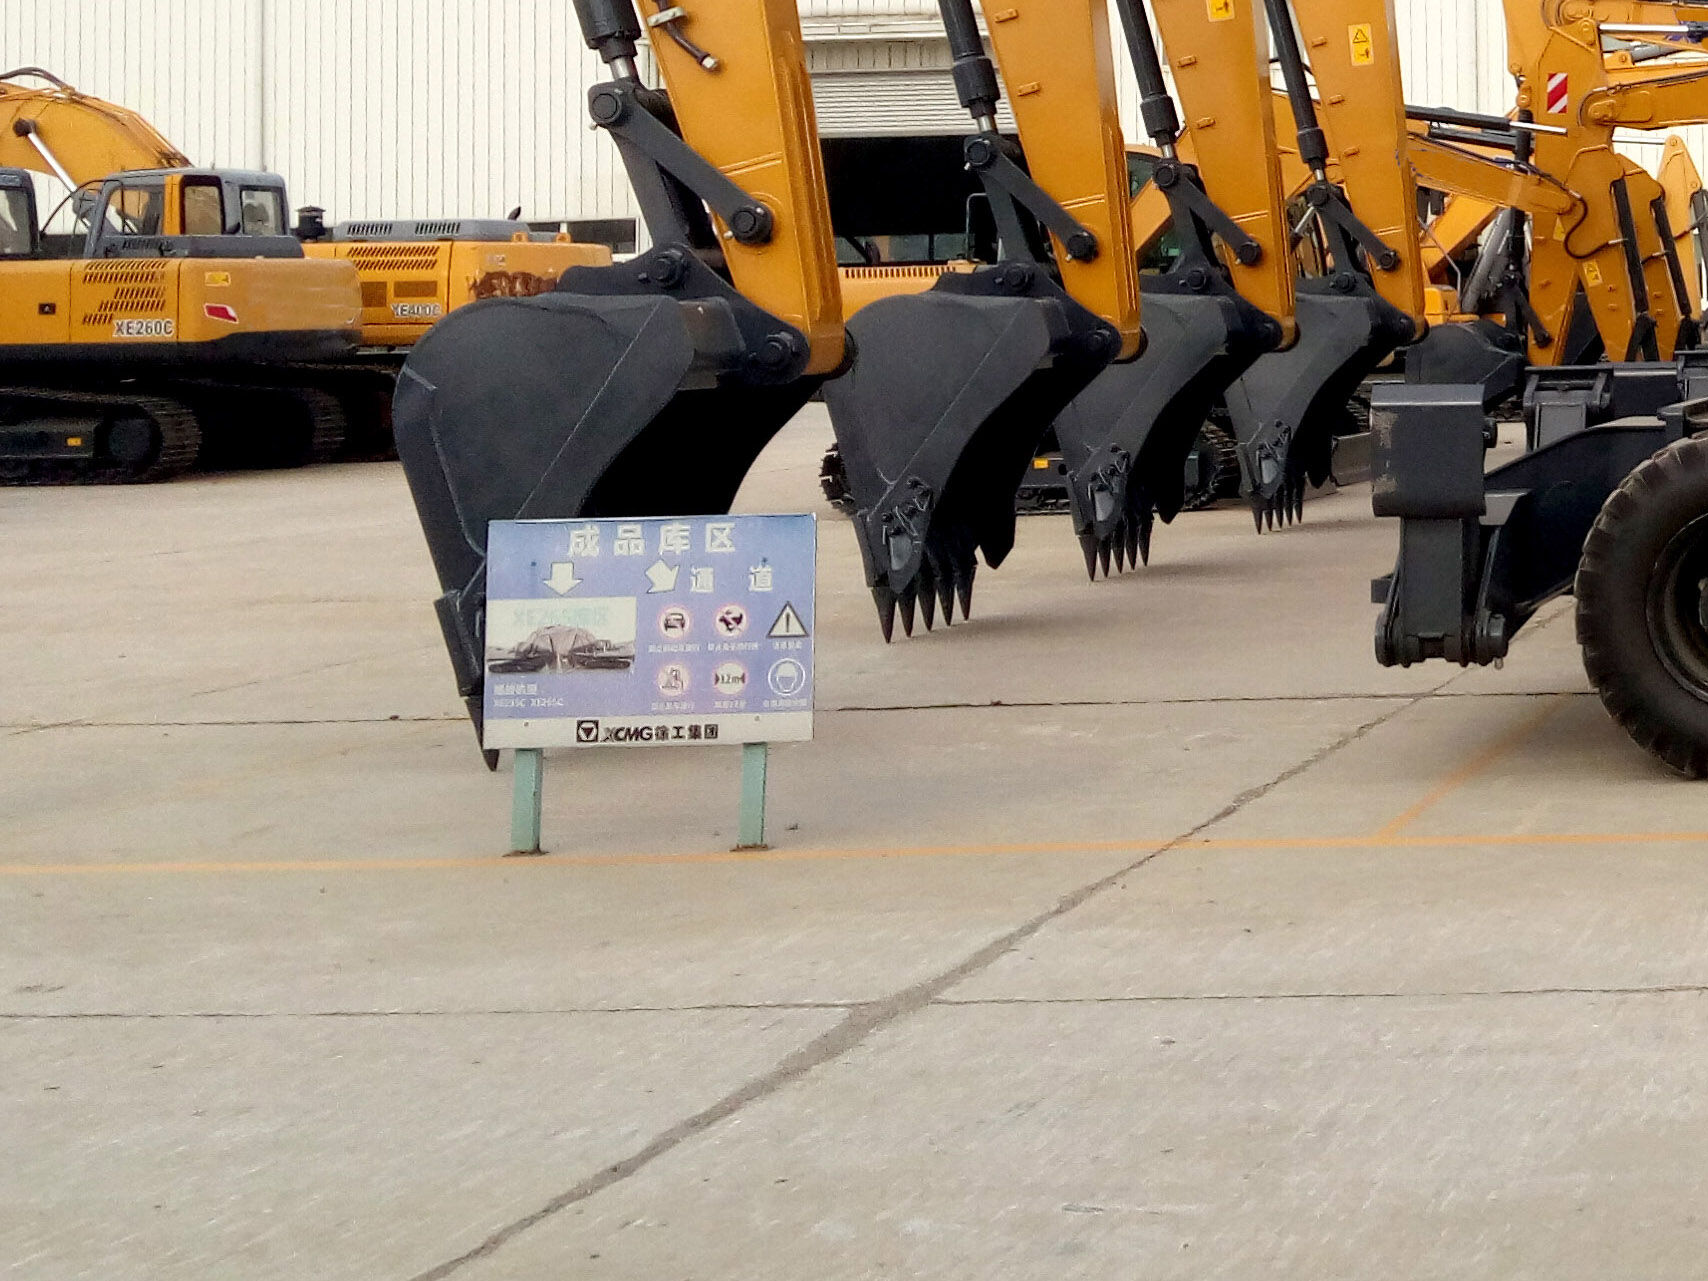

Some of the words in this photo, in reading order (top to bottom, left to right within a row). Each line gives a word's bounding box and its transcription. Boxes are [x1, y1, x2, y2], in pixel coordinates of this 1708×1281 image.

[112, 319, 174, 337] XE260C
[568, 522, 735, 557] 成品库区
